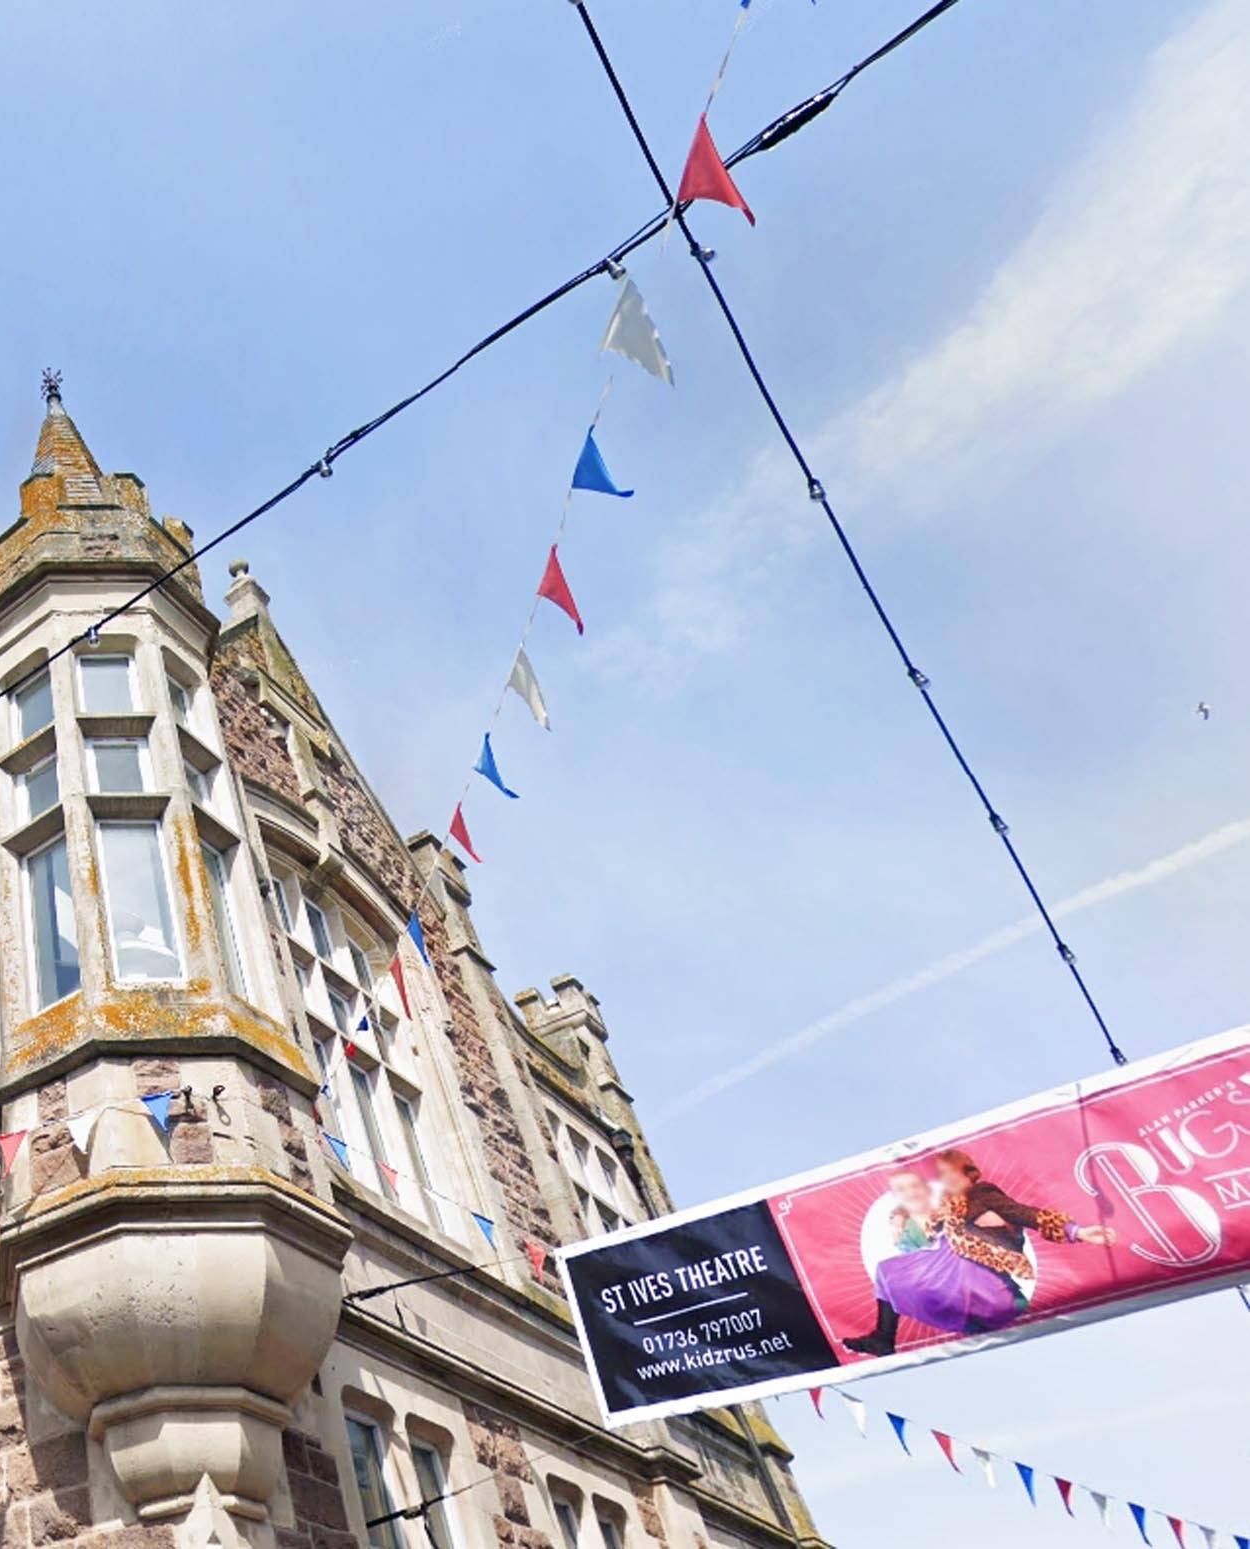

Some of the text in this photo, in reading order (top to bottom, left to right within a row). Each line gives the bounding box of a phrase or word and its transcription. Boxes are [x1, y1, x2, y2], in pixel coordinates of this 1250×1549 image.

[1138, 1080, 1237, 1138] ALAN PARKER'S
[601, 1246, 768, 1314] ST IVES THEATRE
[636, 1331, 793, 1381] www.kidzrus.net
[642, 1308, 763, 1355] 01736 797007
